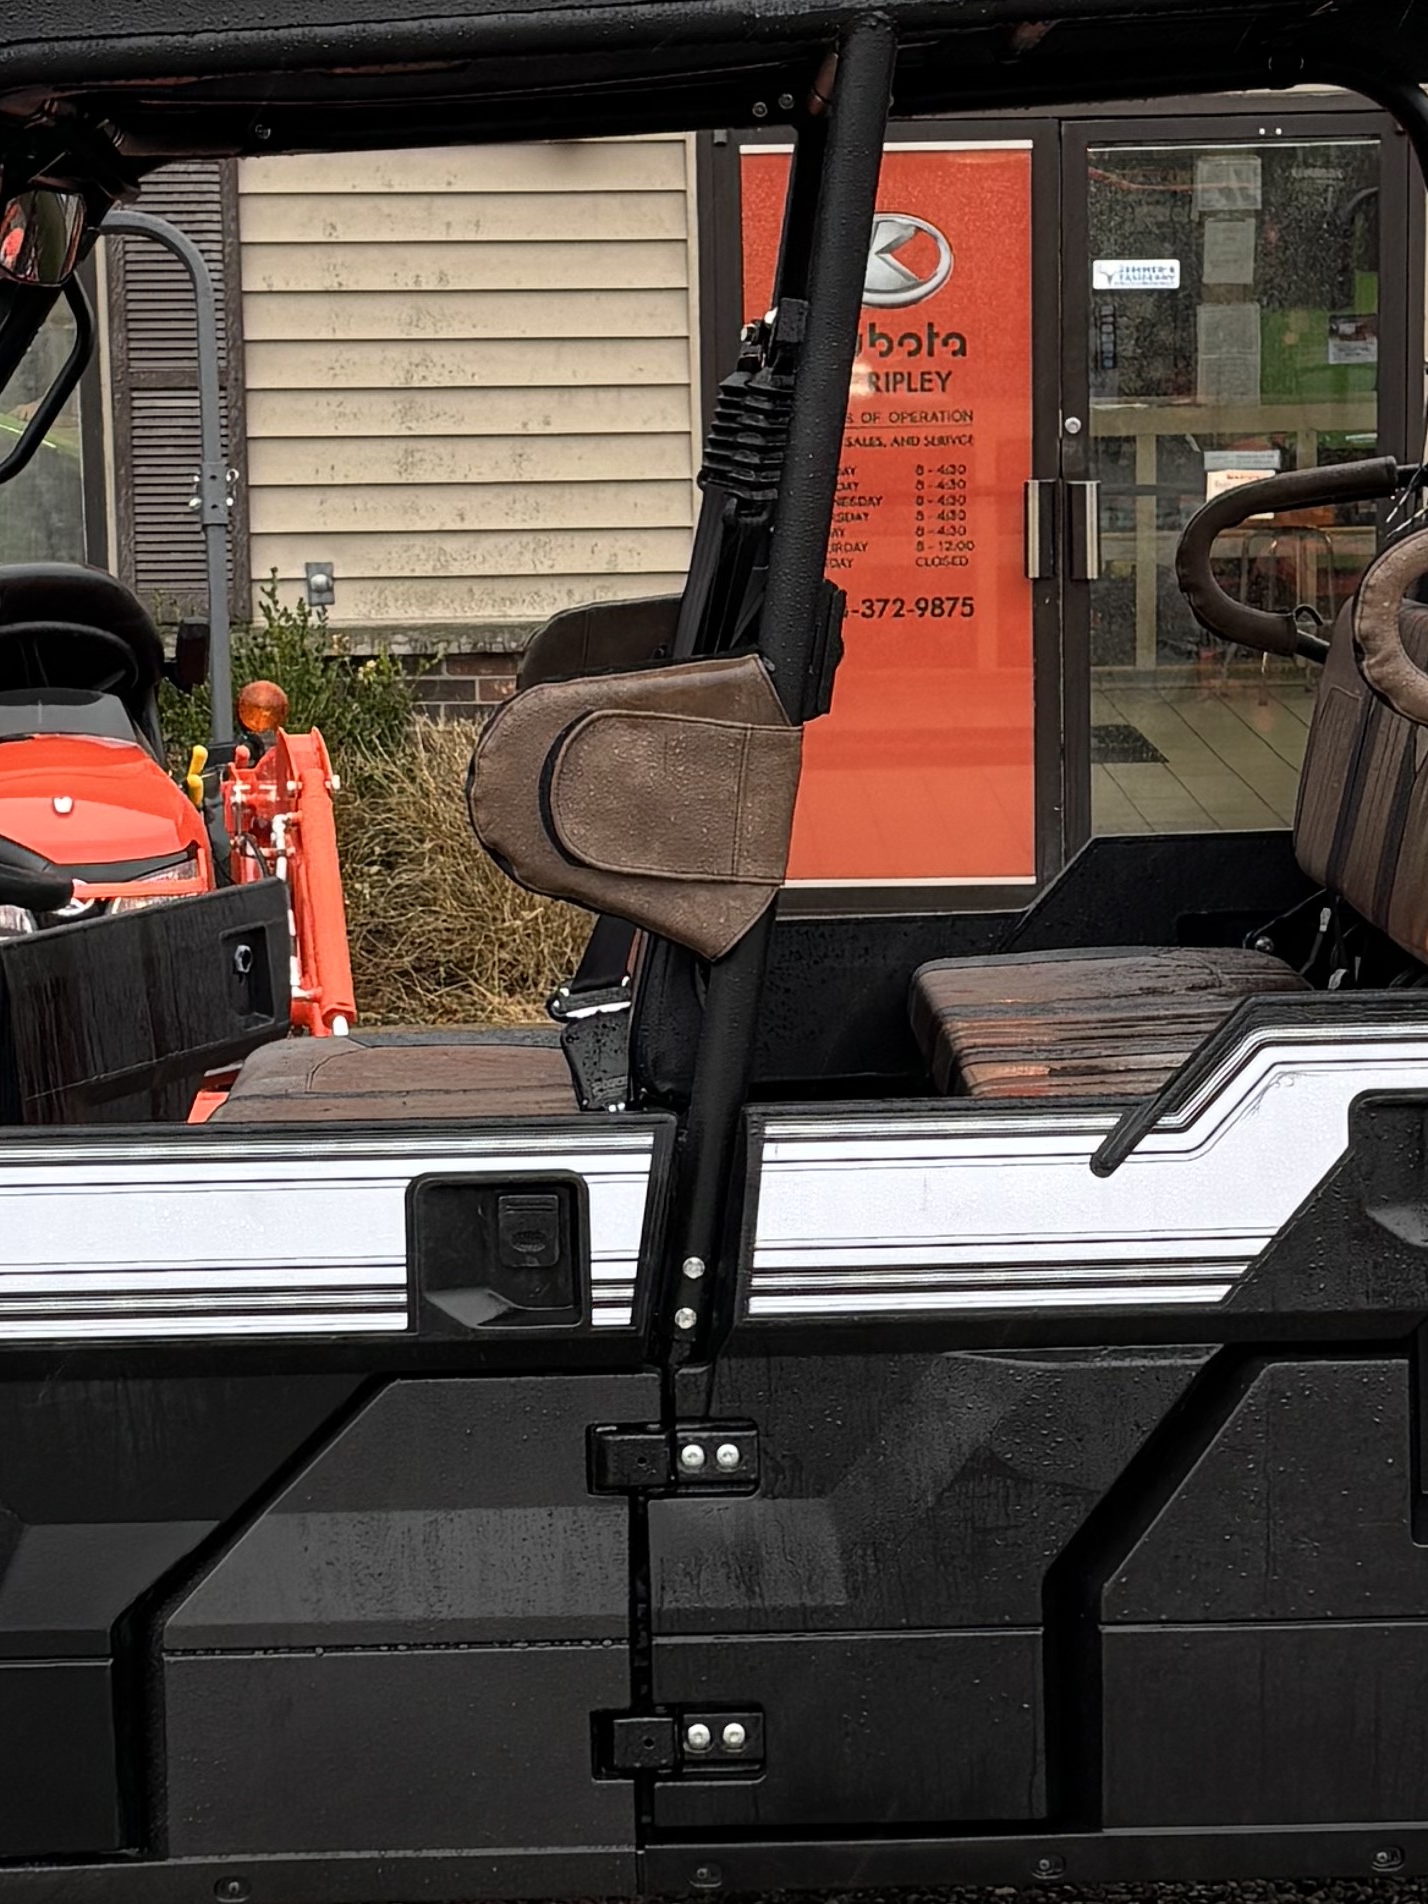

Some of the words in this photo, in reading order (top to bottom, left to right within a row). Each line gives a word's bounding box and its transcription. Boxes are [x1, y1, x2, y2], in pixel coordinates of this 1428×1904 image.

[856, 322, 968, 358] bota
[868, 371, 953, 394] RIPLEY
[888, 409, 974, 425] OPERATION
[834, 495, 883, 507] NESDAY
[844, 596, 976, 619] -372-9875
